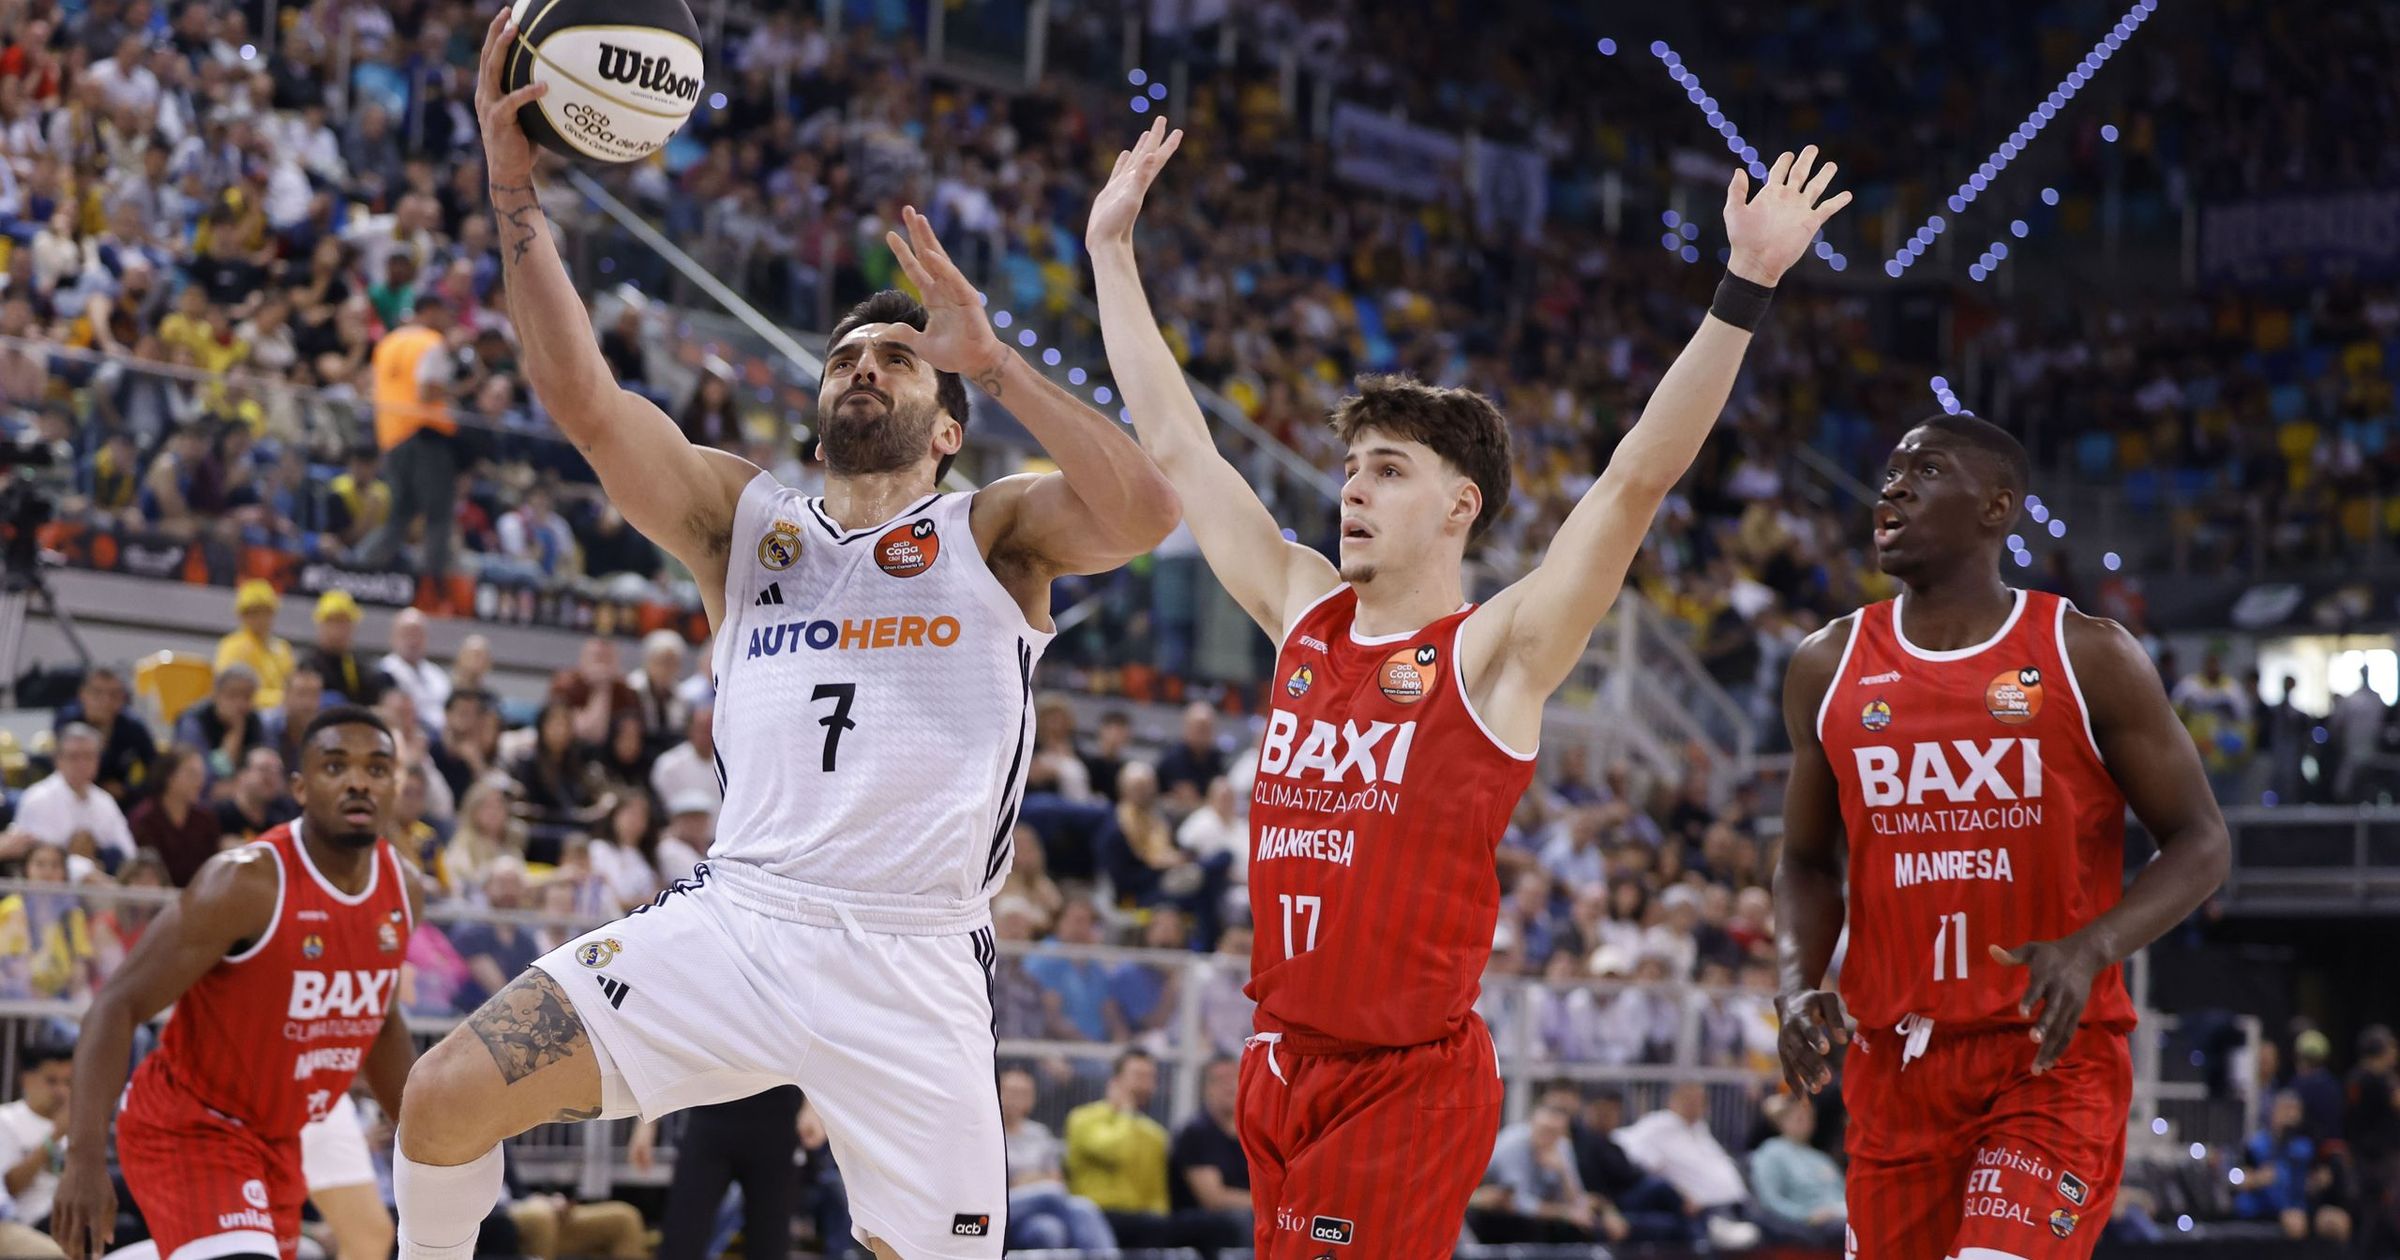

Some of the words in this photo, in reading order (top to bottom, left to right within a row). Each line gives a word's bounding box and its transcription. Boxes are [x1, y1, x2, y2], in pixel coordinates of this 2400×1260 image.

[598, 42, 700, 102] Wilson
[563, 102, 616, 143] Copa
[582, 105, 610, 127] acb
[886, 546, 919, 557] Copa
[902, 553, 923, 564] Rey
[747, 615, 961, 660] AUTOHERO
[1389, 669, 1419, 681] Copa
[1402, 679, 1422, 690] Rey
[810, 683, 856, 772] 7
[1260, 708, 1417, 784] BAXI
[1851, 738, 2043, 807] BAXI
[1255, 781, 1399, 815] CLIMATIZACIÓN
[1871, 802, 2042, 835] CLIMATIZACIÓN
[1257, 825, 1355, 867] MANRESA
[1895, 848, 2013, 888] MANRESA
[1279, 893, 1321, 960] 17
[1933, 911, 1968, 981] 11
[1975, 1147, 2053, 1181] Adbisio
[1968, 1168, 2003, 1194] ETL
[2060, 1182, 2079, 1199] acb
[218, 1207, 274, 1231] unila
[1964, 1196, 2036, 1226] GLOBAL
[955, 1222, 981, 1235] acb
[1315, 1227, 1343, 1240] acb
